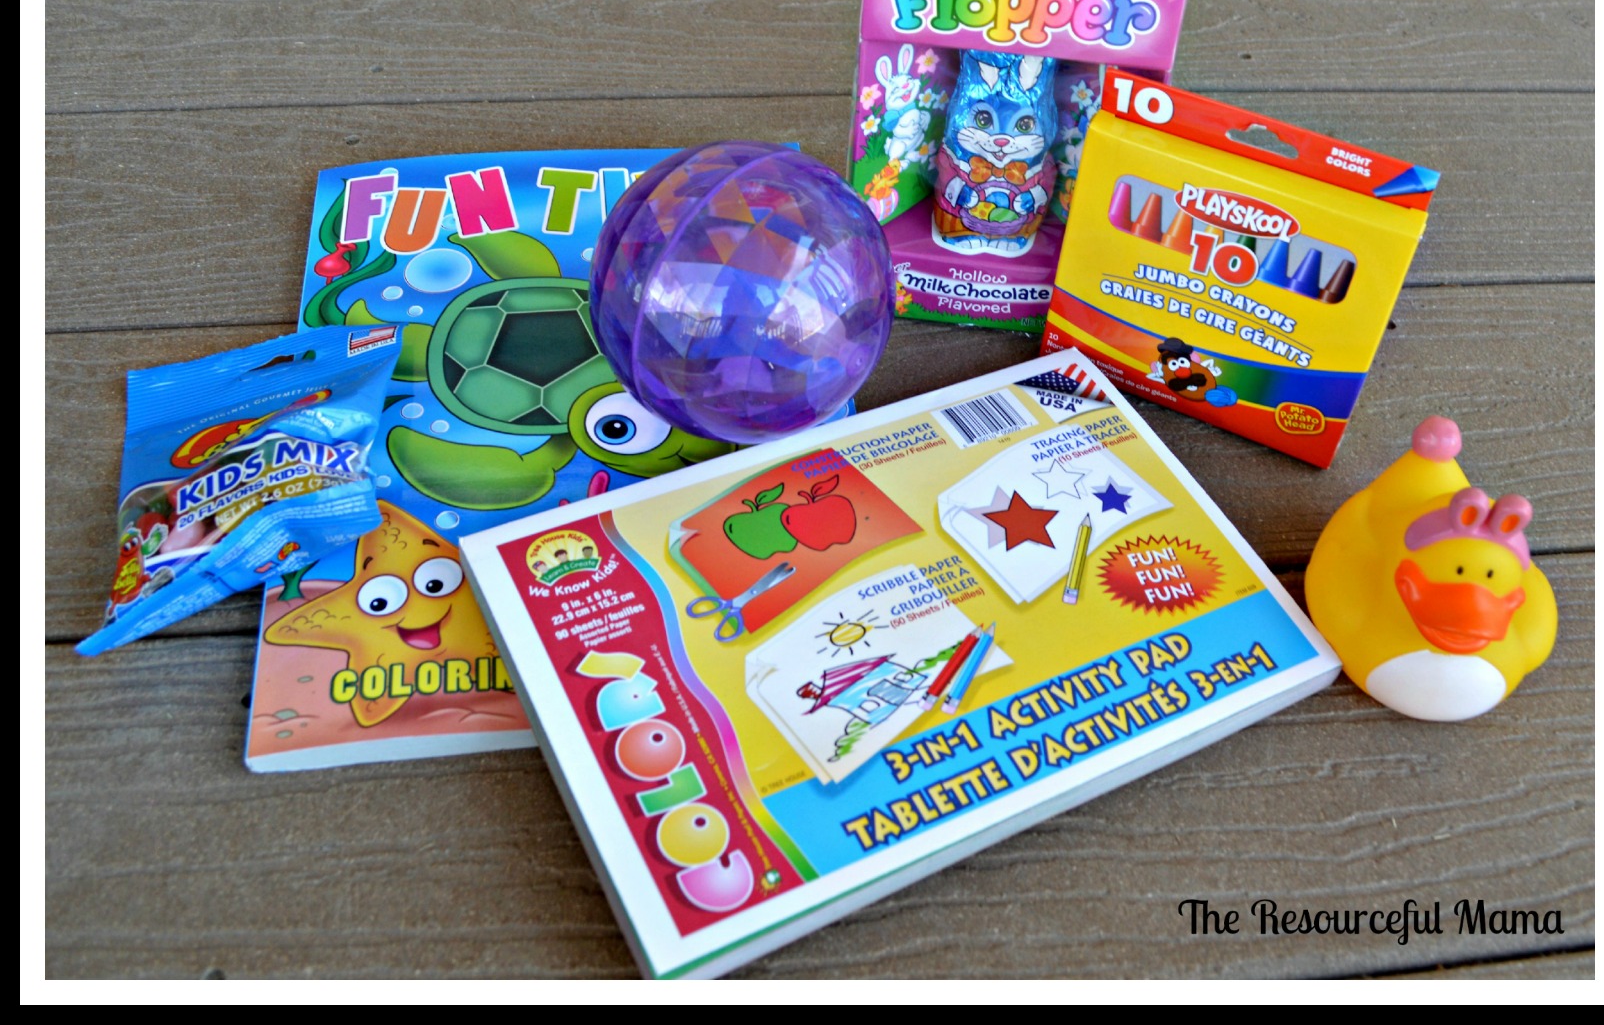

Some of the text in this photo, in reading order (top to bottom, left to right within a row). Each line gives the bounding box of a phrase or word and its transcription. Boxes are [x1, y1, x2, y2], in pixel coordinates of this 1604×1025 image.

[1113, 77, 1175, 124] 10
[1325, 156, 1371, 177] COLORS
[1331, 146, 1373, 167] BRIGHT
[340, 166, 519, 255] FUN
[1181, 183, 1292, 243] PLAYSKOOL
[1188, 230, 1260, 287] 10
[903, 273, 1050, 301] Milk Chocolate
[949, 267, 1008, 284] Hollow
[937, 296, 1011, 314] Flavored
[1134, 264, 1297, 334] JUMBO CRAYONS
[1100, 280, 1313, 367] CRAIES DE CIRE GÉANTS
[1036, 390, 1083, 405] MADE IN
[1040, 397, 1077, 413] USA
[1280, 411, 1319, 424] Potato
[1284, 420, 1315, 431] Head
[1031, 427, 1087, 450] TRACING
[1086, 415, 1122, 432] PAPER
[1031, 446, 1074, 463] PAPIER
[1087, 425, 1131, 443] TRACER
[791, 422, 932, 472] CONSTRUCTION PAPER
[804, 430, 939, 479] PAPIER DE BRICOLAGE
[874, 451, 905, 466] Sheets
[177, 453, 264, 513] KIDS
[273, 440, 358, 473] MIX
[177, 514, 195, 530] 20
[198, 481, 265, 521] FLAVORS
[268, 464, 311, 485] KIDS
[261, 487, 281, 502] 2.6
[285, 481, 304, 495] OZ
[1127, 547, 1177, 568] FUN!
[529, 585, 549, 597] We
[554, 579, 590, 596] Know
[858, 555, 962, 600] SCRIBBLE PAPER
[909, 570, 957, 595] PAPIER
[1135, 564, 1186, 586] FUN!
[890, 577, 978, 616] GRIBOUILLER
[1144, 582, 1195, 604] FUN!
[552, 612, 574, 626] 22.9
[598, 596, 619, 609] 15.2
[620, 591, 635, 602] cm
[907, 604, 940, 622] Sheets
[555, 628, 569, 641] 90
[881, 632, 1192, 784] 3-IN-1 ACTIVITY PAD
[842, 758, 1013, 852] TABLETTE
[1007, 679, 1190, 779] D'ACTIVITÉS
[1190, 641, 1279, 700] 3-EN-1
